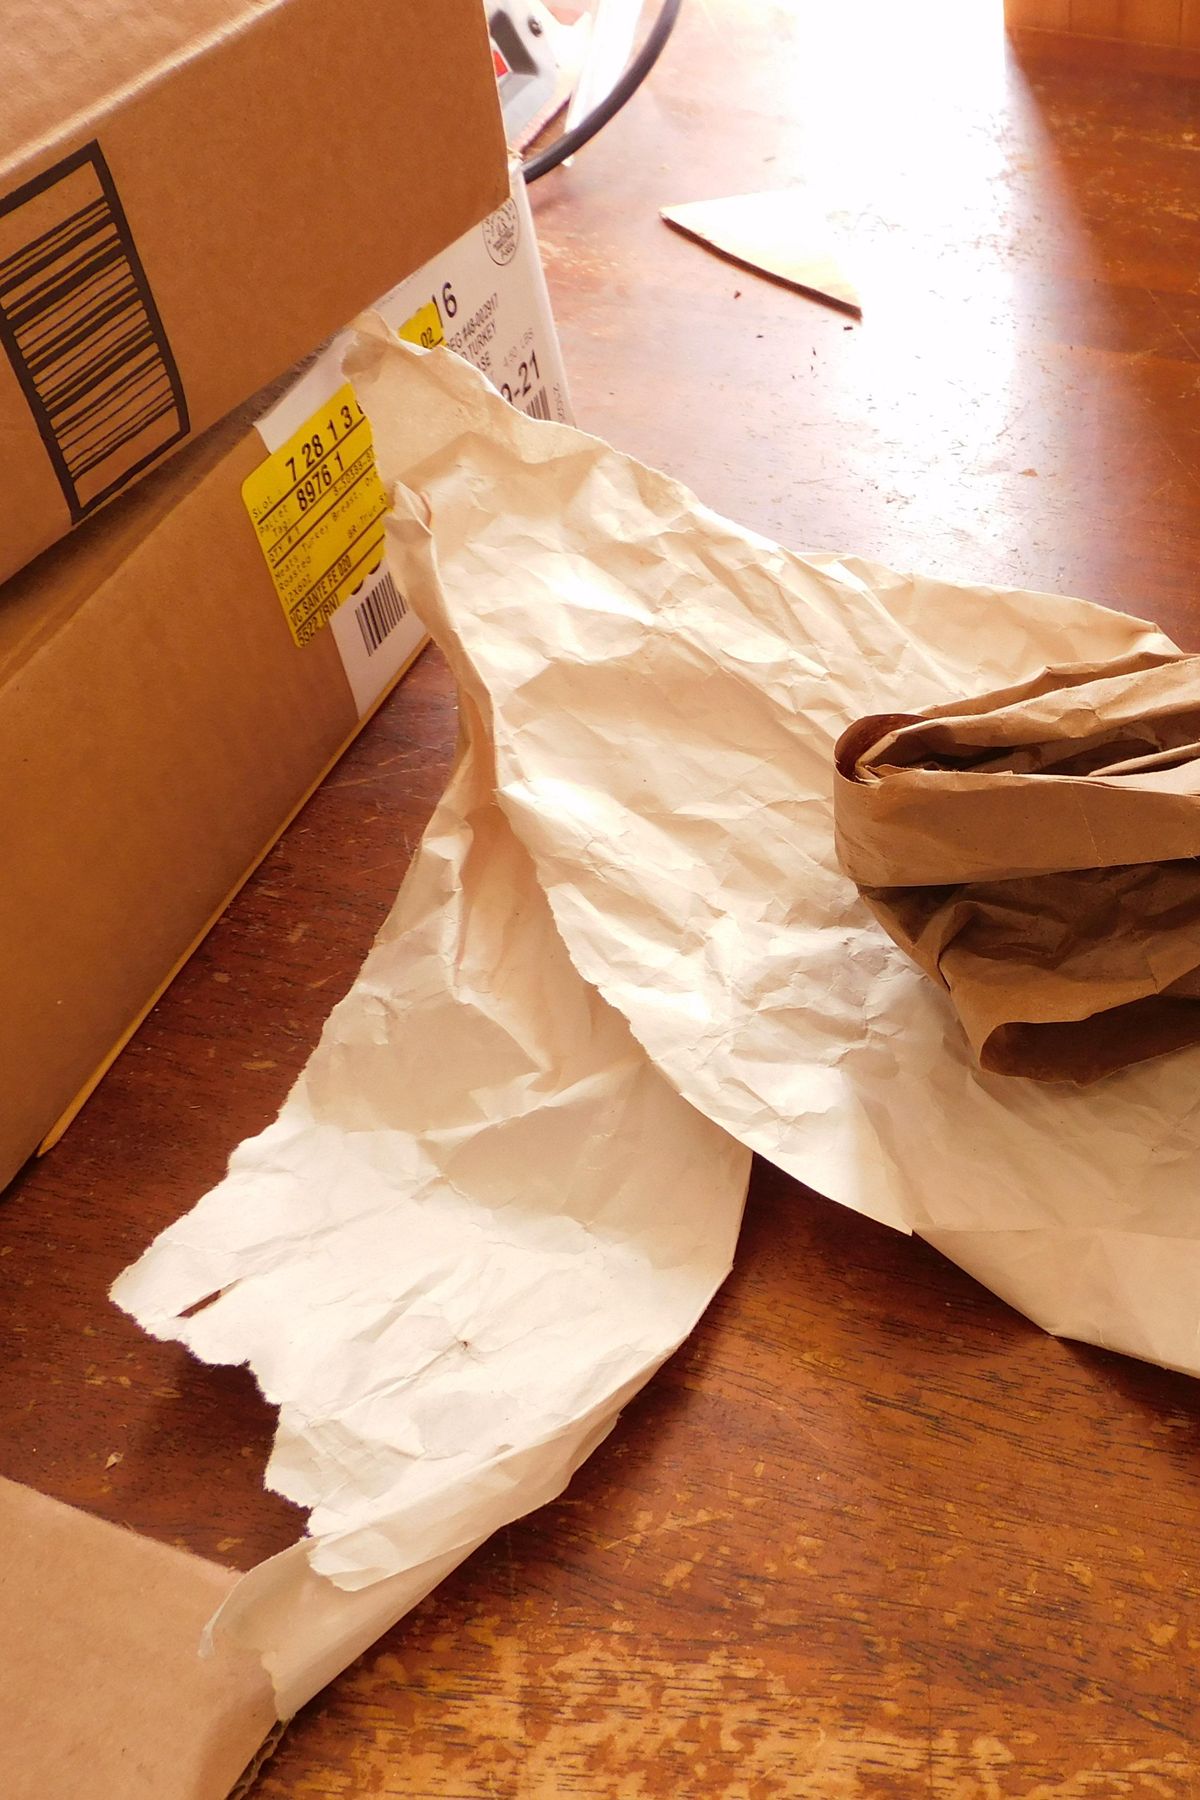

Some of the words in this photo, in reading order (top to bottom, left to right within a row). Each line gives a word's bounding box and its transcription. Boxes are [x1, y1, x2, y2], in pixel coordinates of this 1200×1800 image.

[468, 319, 496, 359] TURKEY
[285, 456, 297, 482] 7
[302, 434, 324, 469] 28
[327, 419, 338, 441] 1
[340, 405, 353, 429] 3
[297, 464, 332, 511] 8976
[334, 451, 344, 471] 1
[303, 580, 328, 616] SANTE
[327, 569, 339, 588] FE
